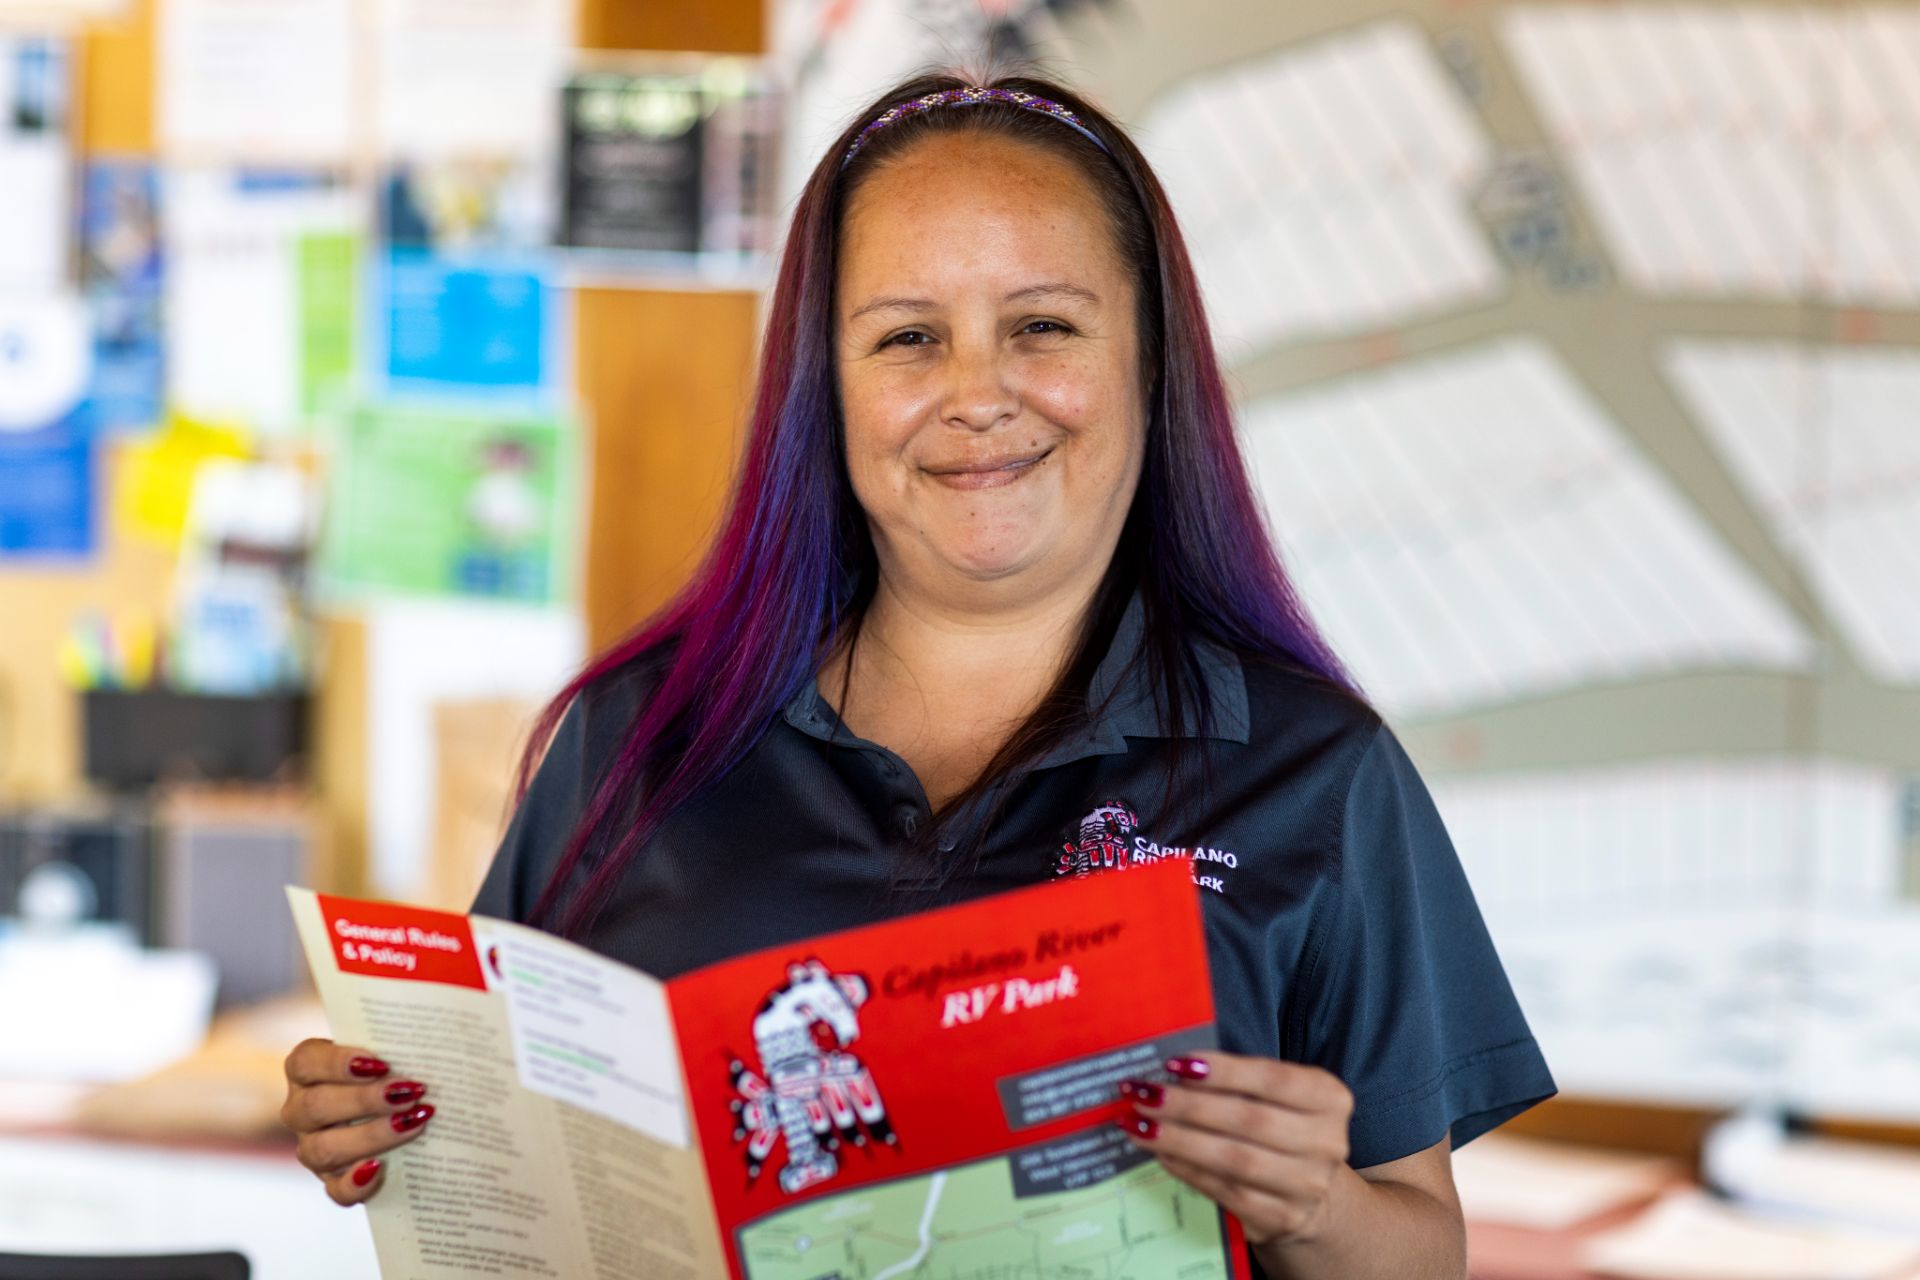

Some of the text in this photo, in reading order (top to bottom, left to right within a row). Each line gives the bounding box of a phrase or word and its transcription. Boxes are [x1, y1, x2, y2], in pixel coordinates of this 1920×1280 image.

[1190, 874, 1224, 894] ARK
[334, 918, 463, 953] General Rules
[341, 941, 417, 972] & Policy
[882, 920, 1125, 1000] Capilano River
[941, 964, 1079, 1029] RV Park
